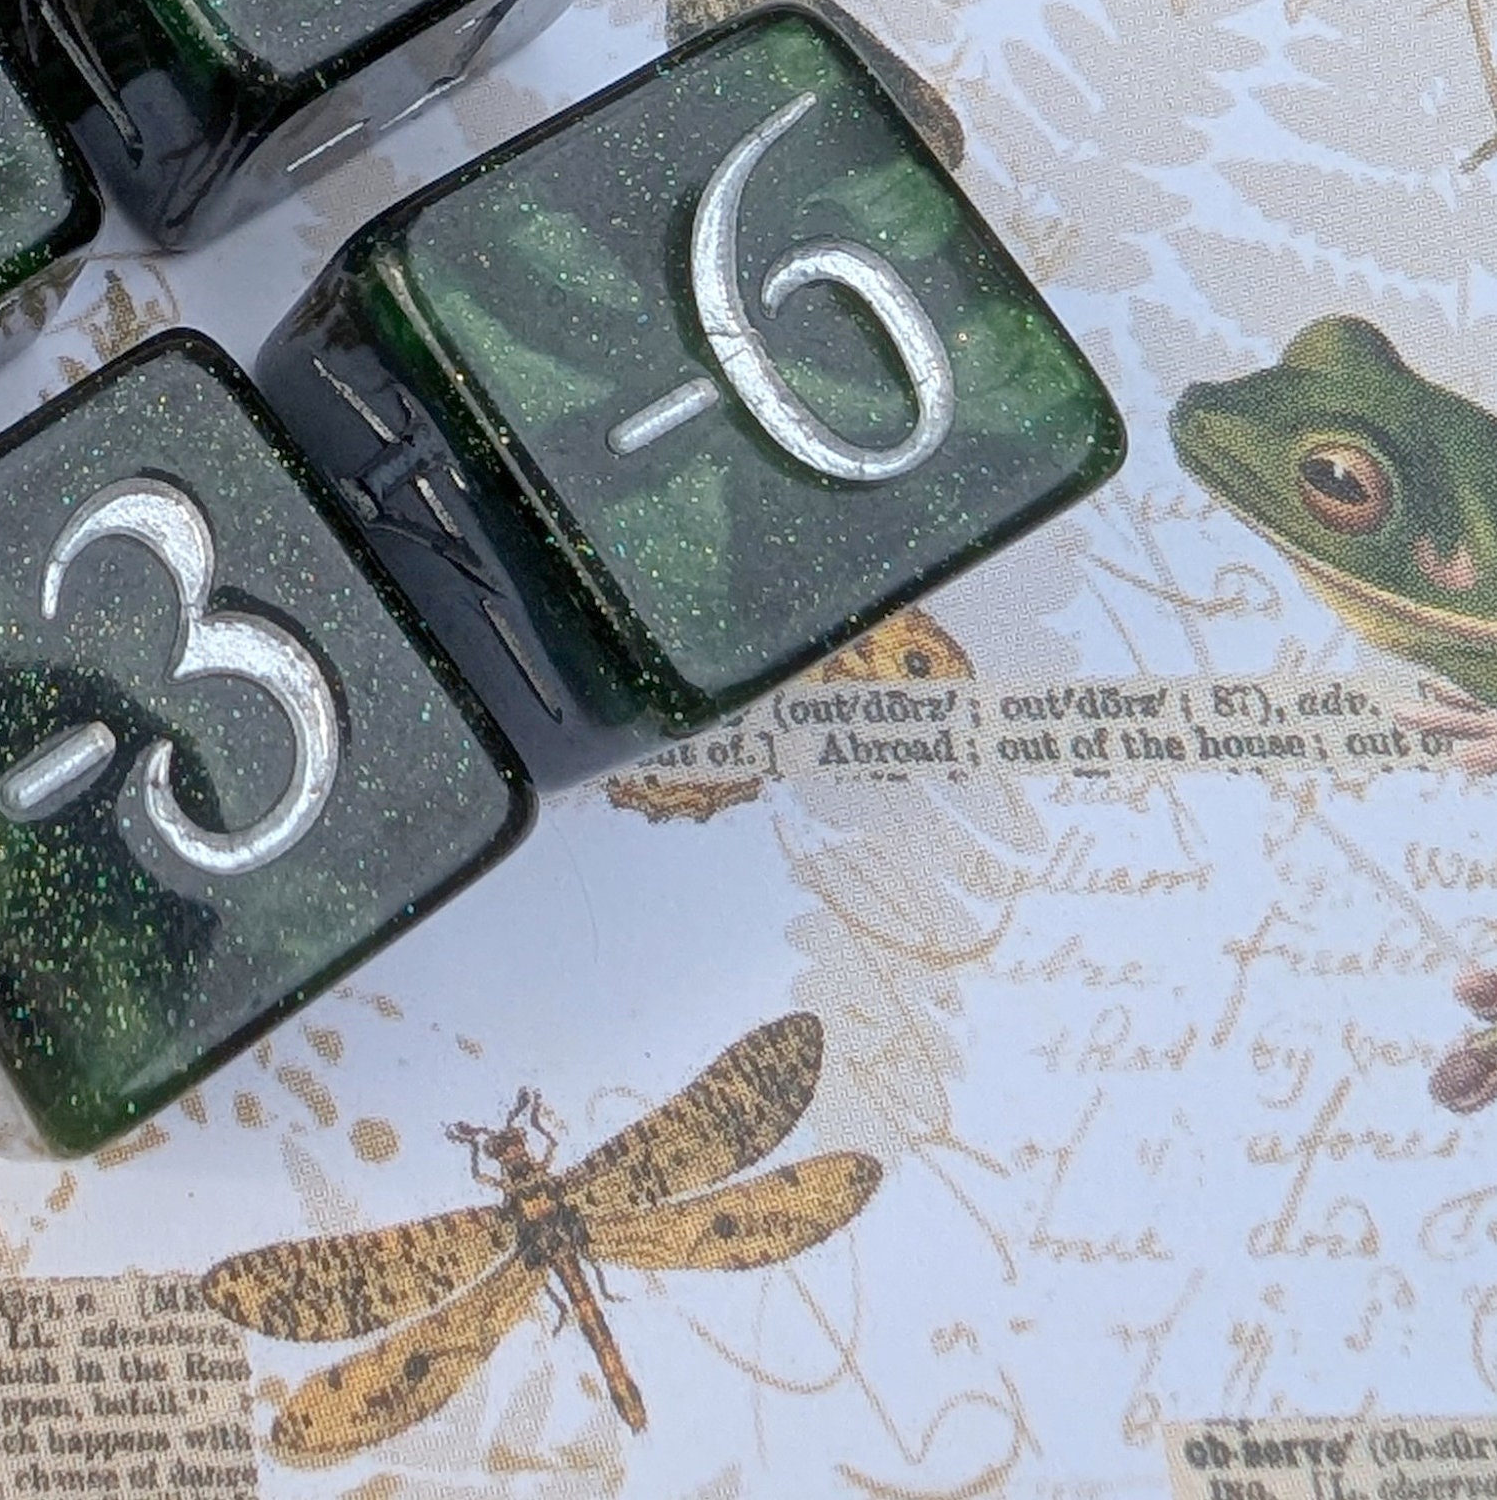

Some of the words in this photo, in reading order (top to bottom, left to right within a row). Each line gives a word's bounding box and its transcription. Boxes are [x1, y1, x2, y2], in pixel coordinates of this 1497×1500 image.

[604, 90, 958, 482] -6
[1297, 682, 1381, 719] adv.
[999, 731, 1061, 762] out
[1069, 728, 1108, 760] of
[1121, 728, 1187, 759] the
[1344, 727, 1412, 759] out
[75, 1355, 103, 1383] in
[119, 1354, 168, 1382] the
